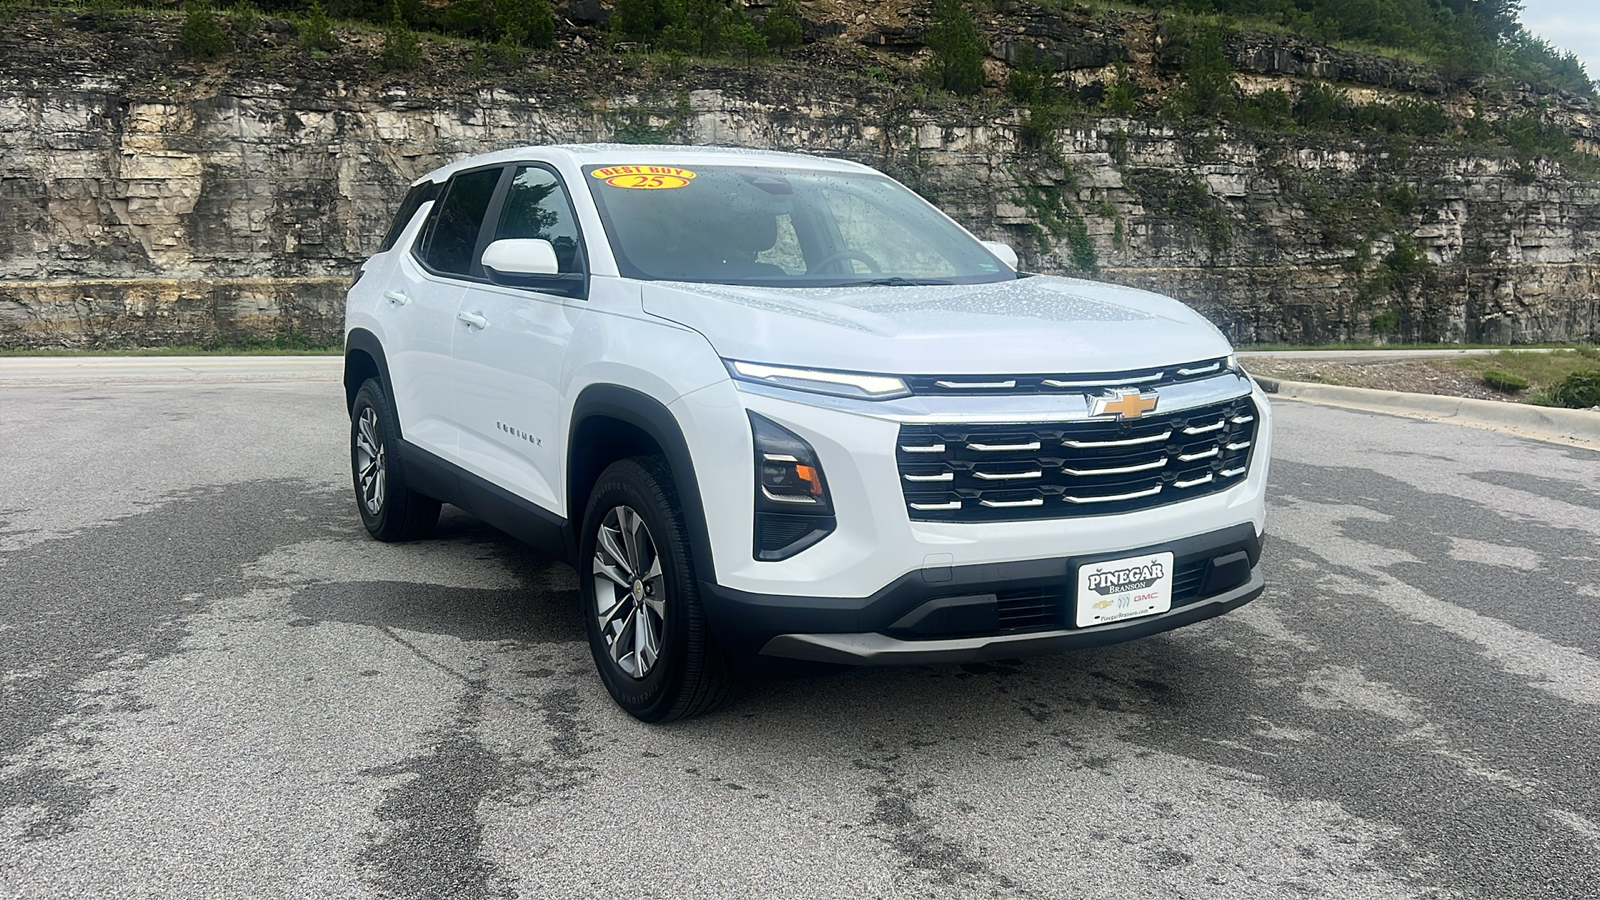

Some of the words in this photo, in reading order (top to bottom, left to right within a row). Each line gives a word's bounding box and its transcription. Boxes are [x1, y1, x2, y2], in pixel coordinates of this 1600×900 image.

[600, 166, 642, 176] BEST
[648, 166, 684, 176] BUY
[631, 175, 665, 188] 25
[1088, 563, 1164, 590] PINEGAR
[1109, 581, 1146, 593] BRANSON
[1133, 592, 1158, 602] GMC
